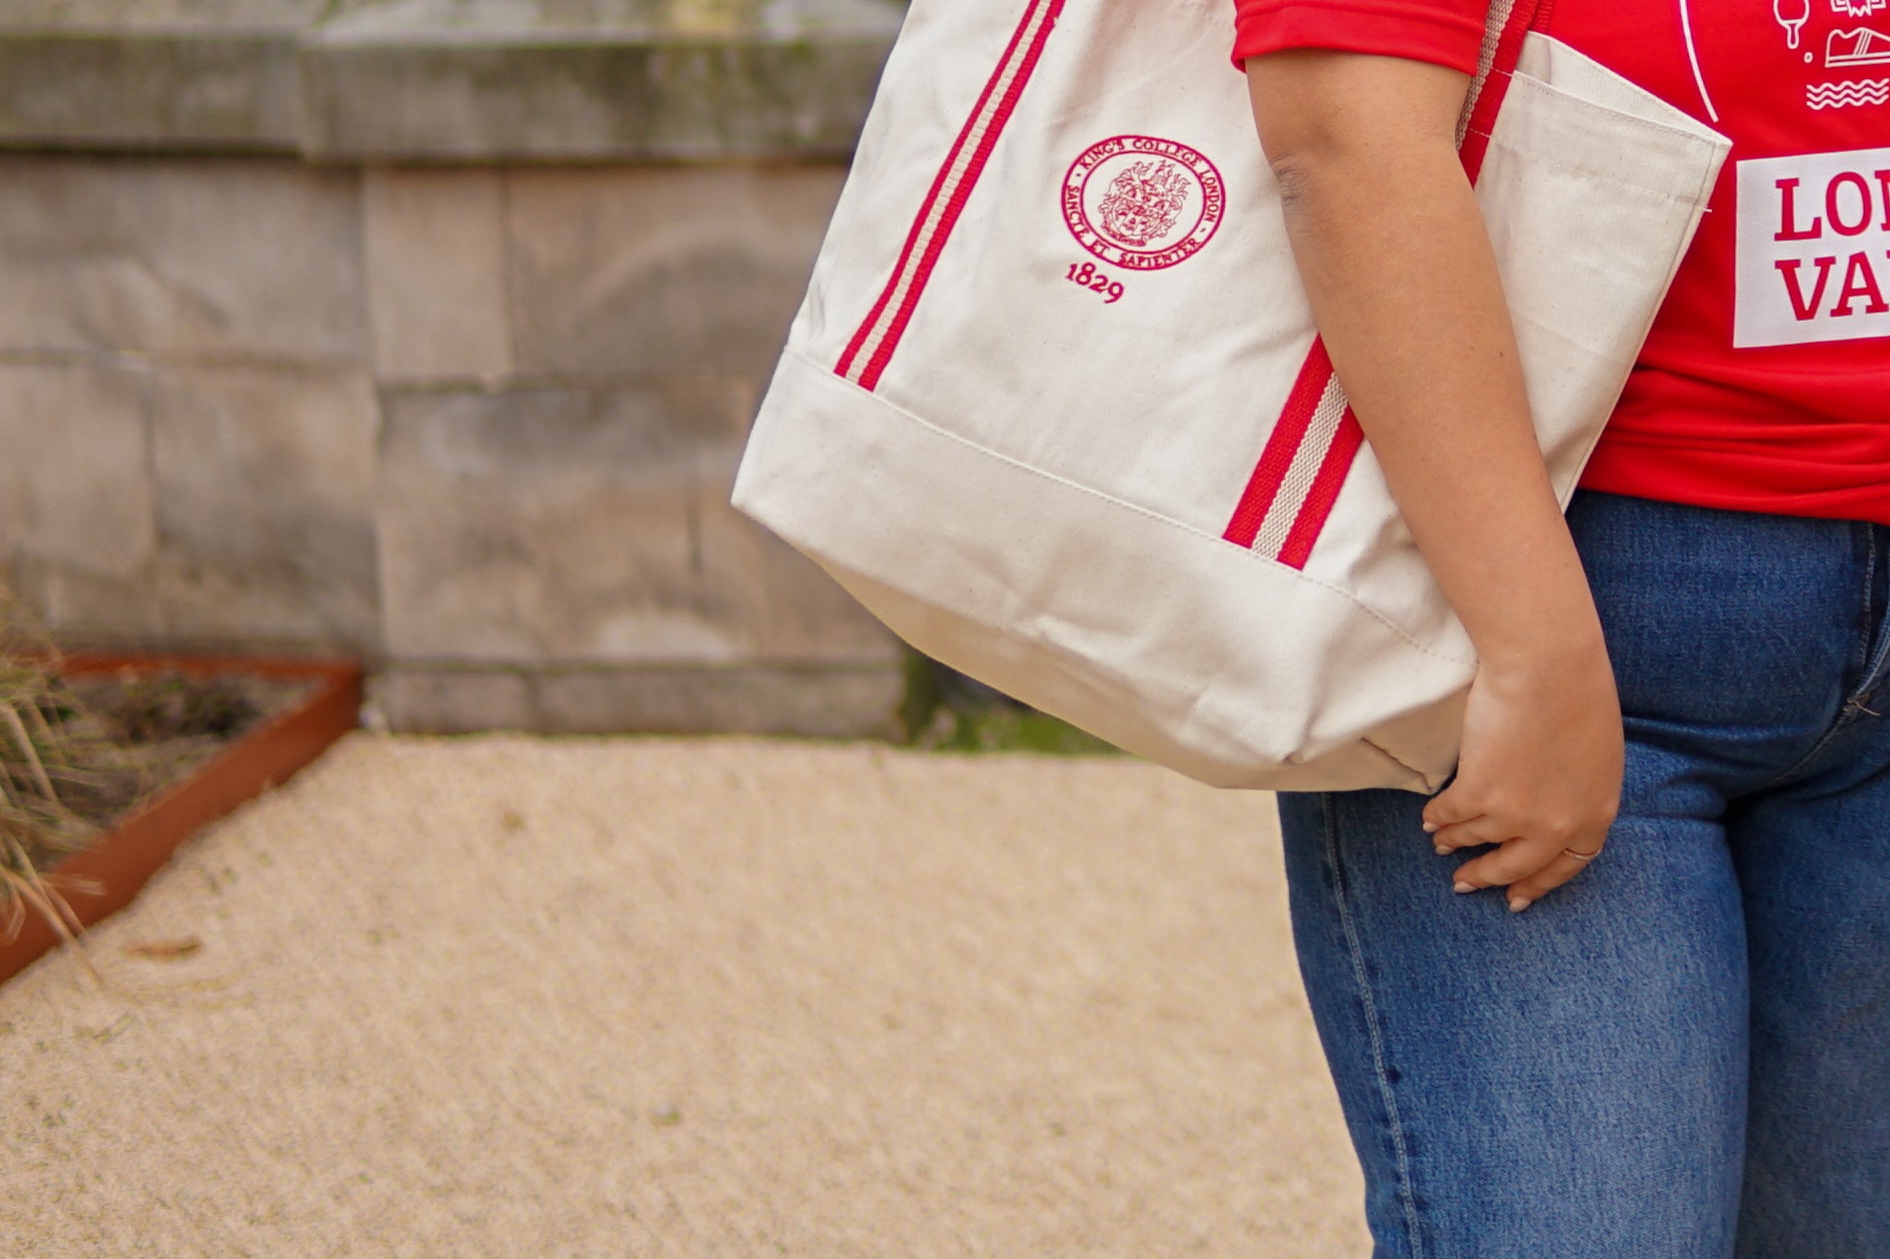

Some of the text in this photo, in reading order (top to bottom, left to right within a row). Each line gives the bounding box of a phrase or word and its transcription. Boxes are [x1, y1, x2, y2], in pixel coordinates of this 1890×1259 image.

[1079, 138, 1220, 223] KING'S COLLEGE LONDON
[1066, 184, 1091, 238] SANCTE
[1088, 239, 1111, 256] ET
[1119, 237, 1200, 268] SAPIENTER
[1065, 262, 1125, 304] 1829
